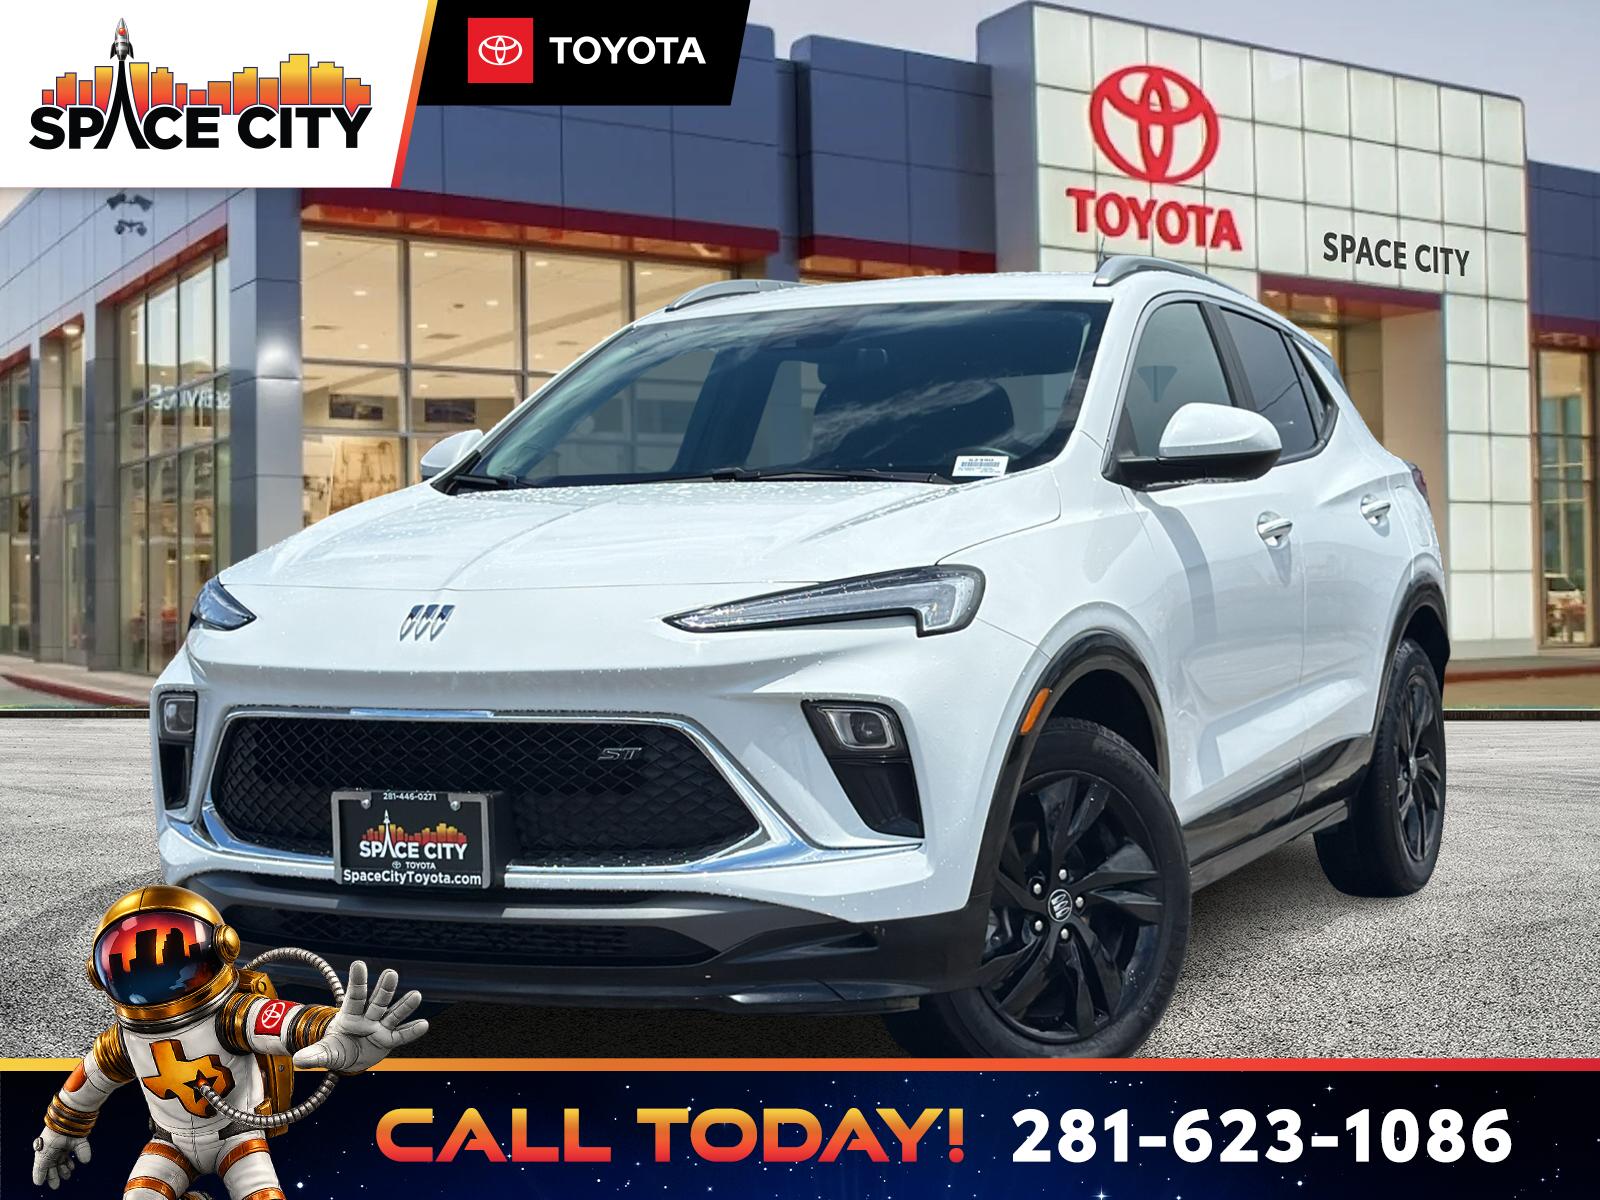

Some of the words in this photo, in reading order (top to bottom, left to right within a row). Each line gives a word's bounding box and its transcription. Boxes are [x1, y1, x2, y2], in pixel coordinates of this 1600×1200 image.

[1066, 187, 1243, 252] TOYOTA
[1322, 231, 1408, 271] SPACE
[1414, 244, 1471, 278] CITY
[597, 747, 642, 760] ST
[383, 792, 437, 801] 281-446-0271
[359, 840, 420, 859] SPACE
[424, 842, 468, 860] CITY
[405, 861, 436, 870] TOYOTA
[343, 869, 482, 886] SpaceCityToyota.com
